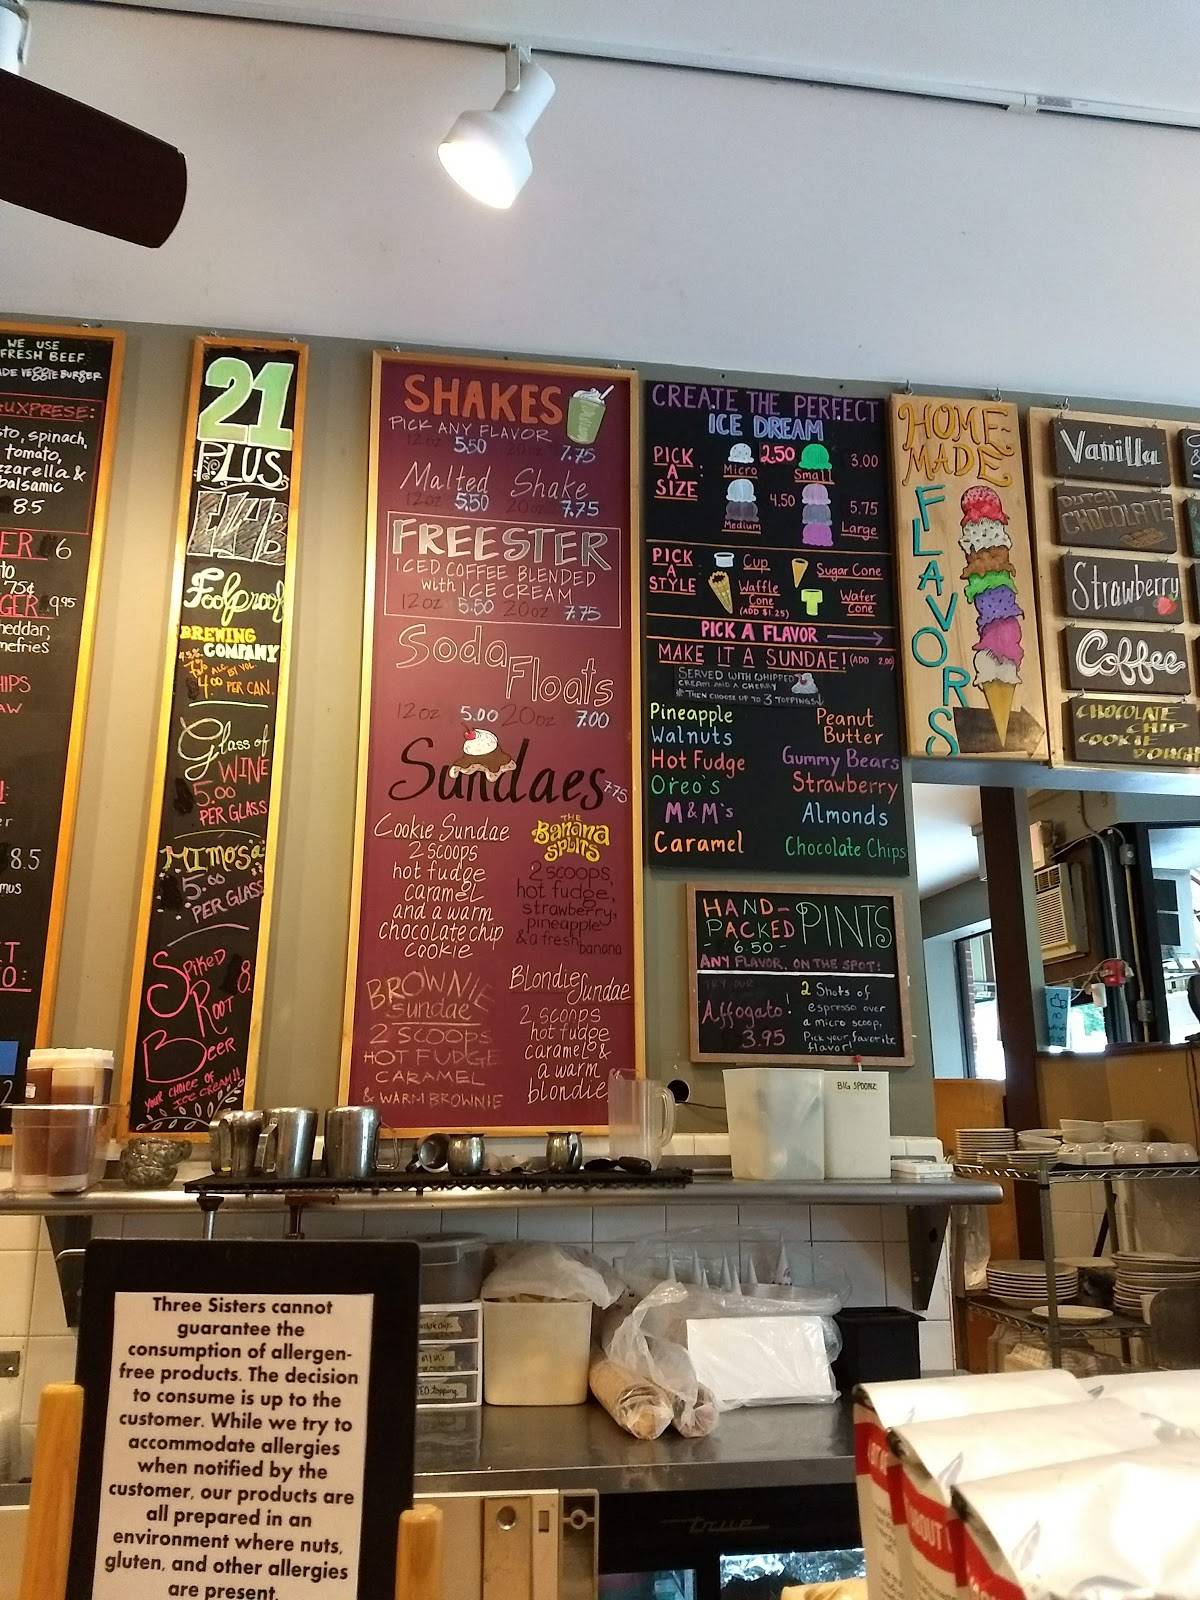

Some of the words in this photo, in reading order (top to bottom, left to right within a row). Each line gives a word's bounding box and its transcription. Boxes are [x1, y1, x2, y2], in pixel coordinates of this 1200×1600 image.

[8, 339, 24, 348] WE
[36, 340, 60, 350] USE
[49, 352, 86, 363] BEEF
[197, 356, 294, 450] 21
[404, 374, 563, 426] SHAKES
[652, 384, 739, 411] CREATE
[747, 390, 781, 416] THE
[794, 395, 880, 423] PERFECT
[28, 428, 89, 449] spinach,
[389, 416, 433, 431] PICK
[438, 422, 475, 437] ANY
[479, 425, 552, 442] FLAVOR
[708, 413, 743, 437] ICE
[754, 415, 824, 441] DREAM
[898, 402, 1015, 457] HOME
[4, 444, 62, 464] tomato,
[454, 436, 487, 454] 5.50
[560, 445, 596, 463] 7.75
[653, 446, 694, 465] PICK
[760, 444, 796, 463] 2.50
[850, 454, 879, 468] 3.00
[1060, 429, 1162, 467] Vanilla
[196, 442, 288, 488] PLUS
[724, 464, 757, 476] Micro
[794, 469, 833, 482] Small
[902, 443, 1013, 488] MADE
[400, 461, 491, 494] Malted
[510, 467, 589, 499] Shake
[656, 479, 698, 497] SIZE
[12, 498, 45, 514] 8.5
[455, 493, 489, 512] 5.50
[560, 500, 599, 518] 7.75
[769, 494, 795, 507] 4.50
[850, 501, 879, 515] 5.75
[1062, 499, 1174, 535] CHOCOLATE
[841, 521, 878, 541] Large
[56, 538, 72, 559] 6
[392, 518, 612, 571] FREESTER
[653, 548, 693, 564] PICK
[395, 558, 440, 574] ICED
[446, 561, 508, 580] COFFEE
[518, 566, 596, 588] BLENDED
[743, 554, 768, 573] Cup
[816, 563, 848, 581] Sugar
[852, 564, 882, 577] Cone
[183, 567, 285, 626] Foolproof
[421, 576, 456, 593] with
[462, 582, 497, 598] ICE
[503, 583, 572, 604] CREAM
[650, 576, 696, 593] STYLE
[739, 580, 779, 594] Waffle
[840, 589, 876, 603] Wafer
[1072, 561, 1180, 611] Strawberry
[458, 598, 494, 616] 5.50
[564, 605, 600, 621] 7.75
[912, 483, 971, 757] FLAVORS
[180, 625, 256, 643] BREWING
[701, 620, 735, 639] PICK
[741, 623, 755, 641] A
[763, 624, 819, 643] FLAVOR
[203, 643, 280, 662] COMPANY
[396, 624, 507, 668] Soda
[659, 643, 704, 663] MAKE
[717, 646, 734, 664] IT
[743, 647, 754, 664] A
[766, 648, 847, 670] SUNDAE!
[1076, 629, 1186, 686] Coffee
[505, 655, 614, 706] Floats
[460, 706, 498, 722] 5.00
[576, 710, 609, 728] 7.00
[650, 702, 734, 727] Pineapple
[816, 708, 874, 727] Peanut
[1076, 704, 1181, 721] CHOCOLATE
[651, 726, 733, 745] Walnuts
[823, 726, 884, 745] Butter
[177, 717, 250, 781] Glass
[254, 724, 270, 757] of
[218, 756, 270, 784] WINE
[388, 736, 607, 811] Sundaes
[651, 749, 687, 770] Hot
[694, 751, 745, 779] Fudge
[782, 746, 841, 777] Gummy
[847, 748, 900, 770] Bears
[192, 780, 236, 807] 5.00
[792, 771, 899, 805] Strawberry
[199, 807, 228, 826] PER
[228, 800, 268, 823] GLASS
[802, 802, 888, 826] Almonds
[374, 813, 435, 838] Cookie
[439, 813, 511, 842] Sundae
[654, 830, 744, 854] Caramel
[785, 836, 861, 858] Chocolate
[867, 837, 907, 865] Chips
[427, 842, 478, 868] scoops
[392, 862, 421, 881] hot
[427, 861, 487, 892] fudge
[393, 902, 425, 920] and
[448, 906, 494, 922] warm
[469, 923, 504, 950] chip
[706, 919, 795, 939] PACKED
[795, 902, 892, 949] PINTS
[404, 942, 474, 959] cookie
[366, 966, 495, 1013] BROWNIE
[567, 973, 632, 1004] Sundae
[816, 982, 850, 997] Shots
[857, 985, 871, 1000] of
[808, 1003, 857, 1016] espresso
[530, 1023, 555, 1042] hot
[559, 1023, 611, 1051] fudge
[742, 1029, 785, 1048] 3.95
[375, 1070, 486, 1086] CARAMEL
[838, 1082, 850, 1090] BIG
[153, 1297, 202, 1312] Three
[208, 1298, 266, 1314] Sisters
[272, 1300, 333, 1314] cannot
[177, 1321, 271, 1338] guarantee
[277, 1321, 305, 1337] the
[128, 1343, 241, 1361] consumption
[248, 1344, 265, 1358] of
[271, 1344, 352, 1364] allergen-
[119, 1363, 155, 1379] free
[160, 1365, 242, 1383] products.
[248, 1367, 279, 1383] The
[285, 1367, 358, 1384] decision
[133, 1389, 150, 1403] to
[157, 1392, 235, 1404] consume
[241, 1390, 254, 1405] is
[260, 1394, 283, 1410] up
[289, 1393, 306, 1407] to
[313, 1391, 341, 1407] the
[119, 1413, 204, 1427] customer.
[211, 1413, 263, 1429] While
[269, 1418, 297, 1429] we
[303, 1417, 328, 1435] try
[335, 1418, 352, 1432] to
[128, 1437, 255, 1453] accommodate
[261, 1438, 340, 1459] allergies
[138, 1460, 187, 1474] when
[194, 1460, 263, 1477] notified
[269, 1462, 292, 1481] by
[299, 1463, 328, 1479] the
[109, 1483, 194, 1500] customer,
[201, 1488, 232, 1499] our
[238, 1487, 317, 1505] products
[324, 1492, 354, 1504] are
[147, 1505, 168, 1521] all
[174, 1508, 260, 1528] prepared
[266, 1510, 282, 1526] in
[289, 1516, 312, 1527] an
